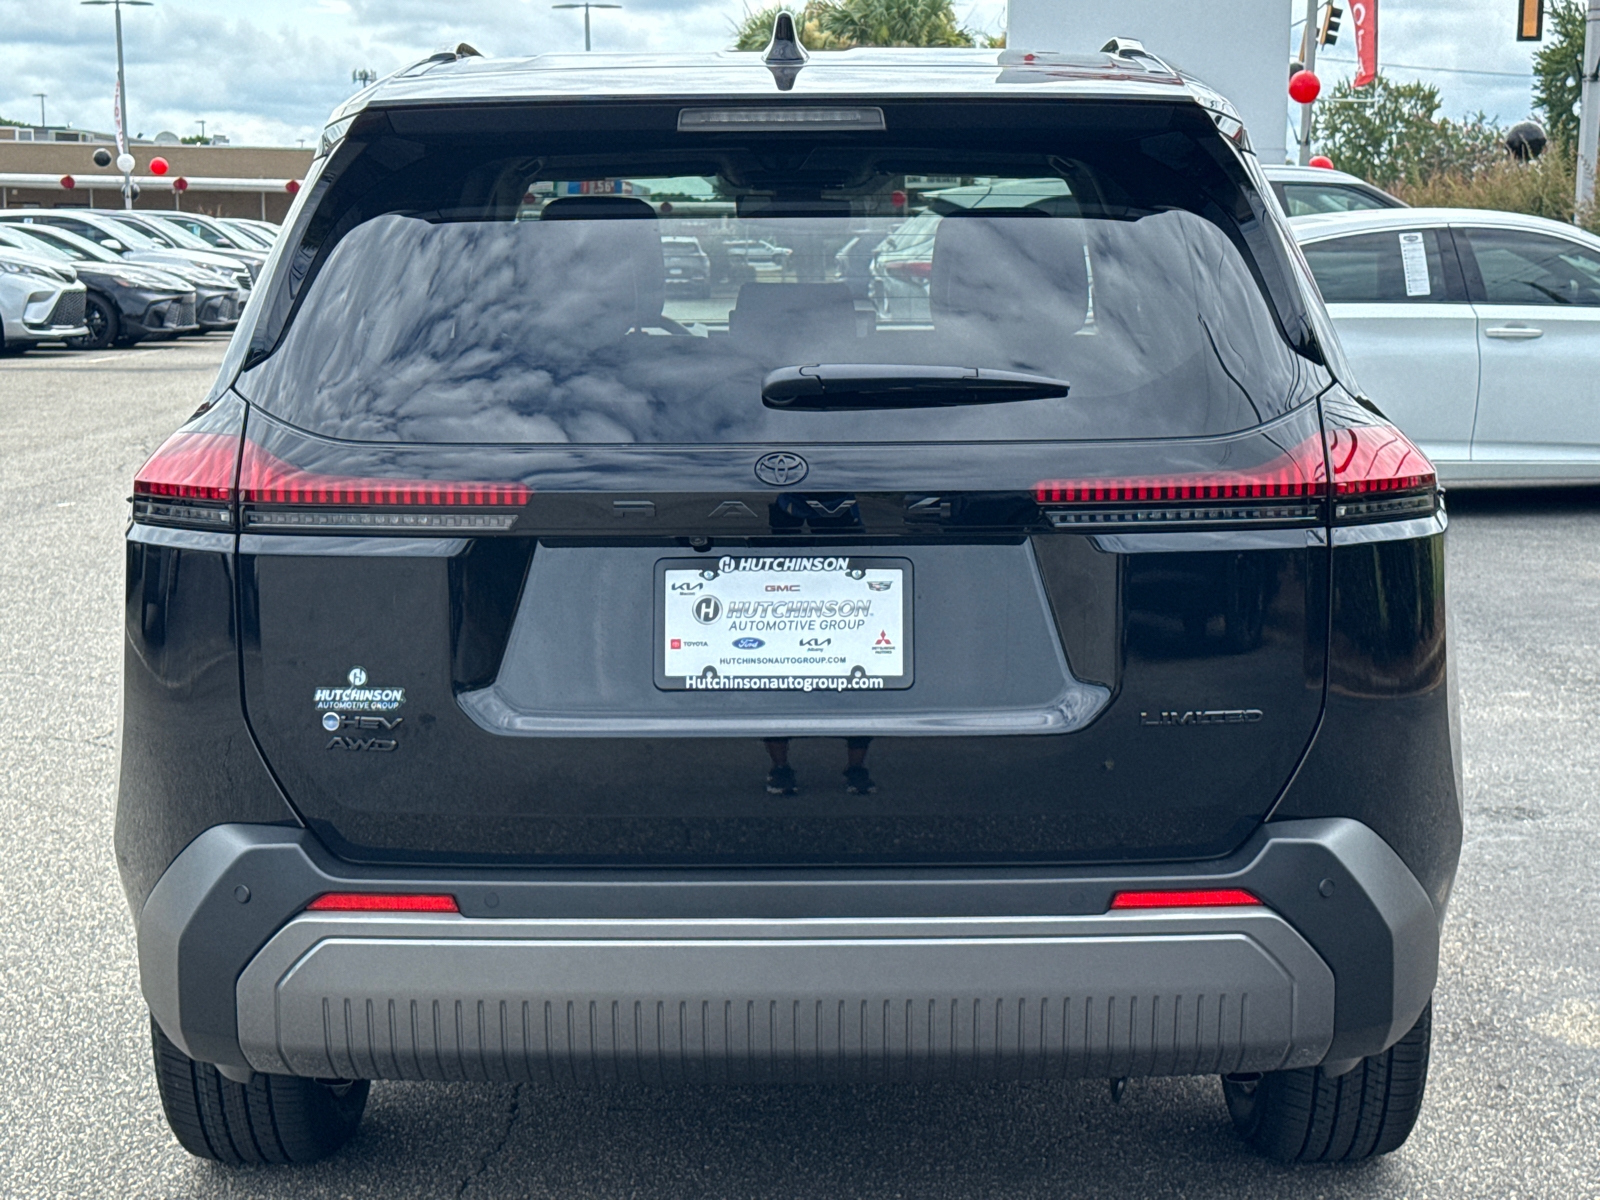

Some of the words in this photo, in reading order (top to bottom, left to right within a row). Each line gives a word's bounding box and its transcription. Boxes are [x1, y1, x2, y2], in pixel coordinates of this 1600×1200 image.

[613, 497, 951, 519] RAV4
[738, 557, 849, 572] HUTCHINSON
[765, 584, 801, 592] GMC
[726, 599, 872, 618] HUTCHINSON
[728, 619, 816, 631] AUTOMOTIVE
[819, 619, 865, 631] GROUP
[738, 638, 759, 648] Ford
[719, 656, 847, 665] HUTCHINSONAUTOGROUP.COM
[685, 675, 884, 692] Hutchinsonautogroup.com
[314, 689, 403, 701] HUTCHINSON
[317, 701, 369, 709] AUTOMOTIVE
[371, 701, 399, 709] GROUP
[340, 715, 403, 730] HEV
[1140, 709, 1263, 725] LIMITED
[326, 736, 398, 751] AWD
